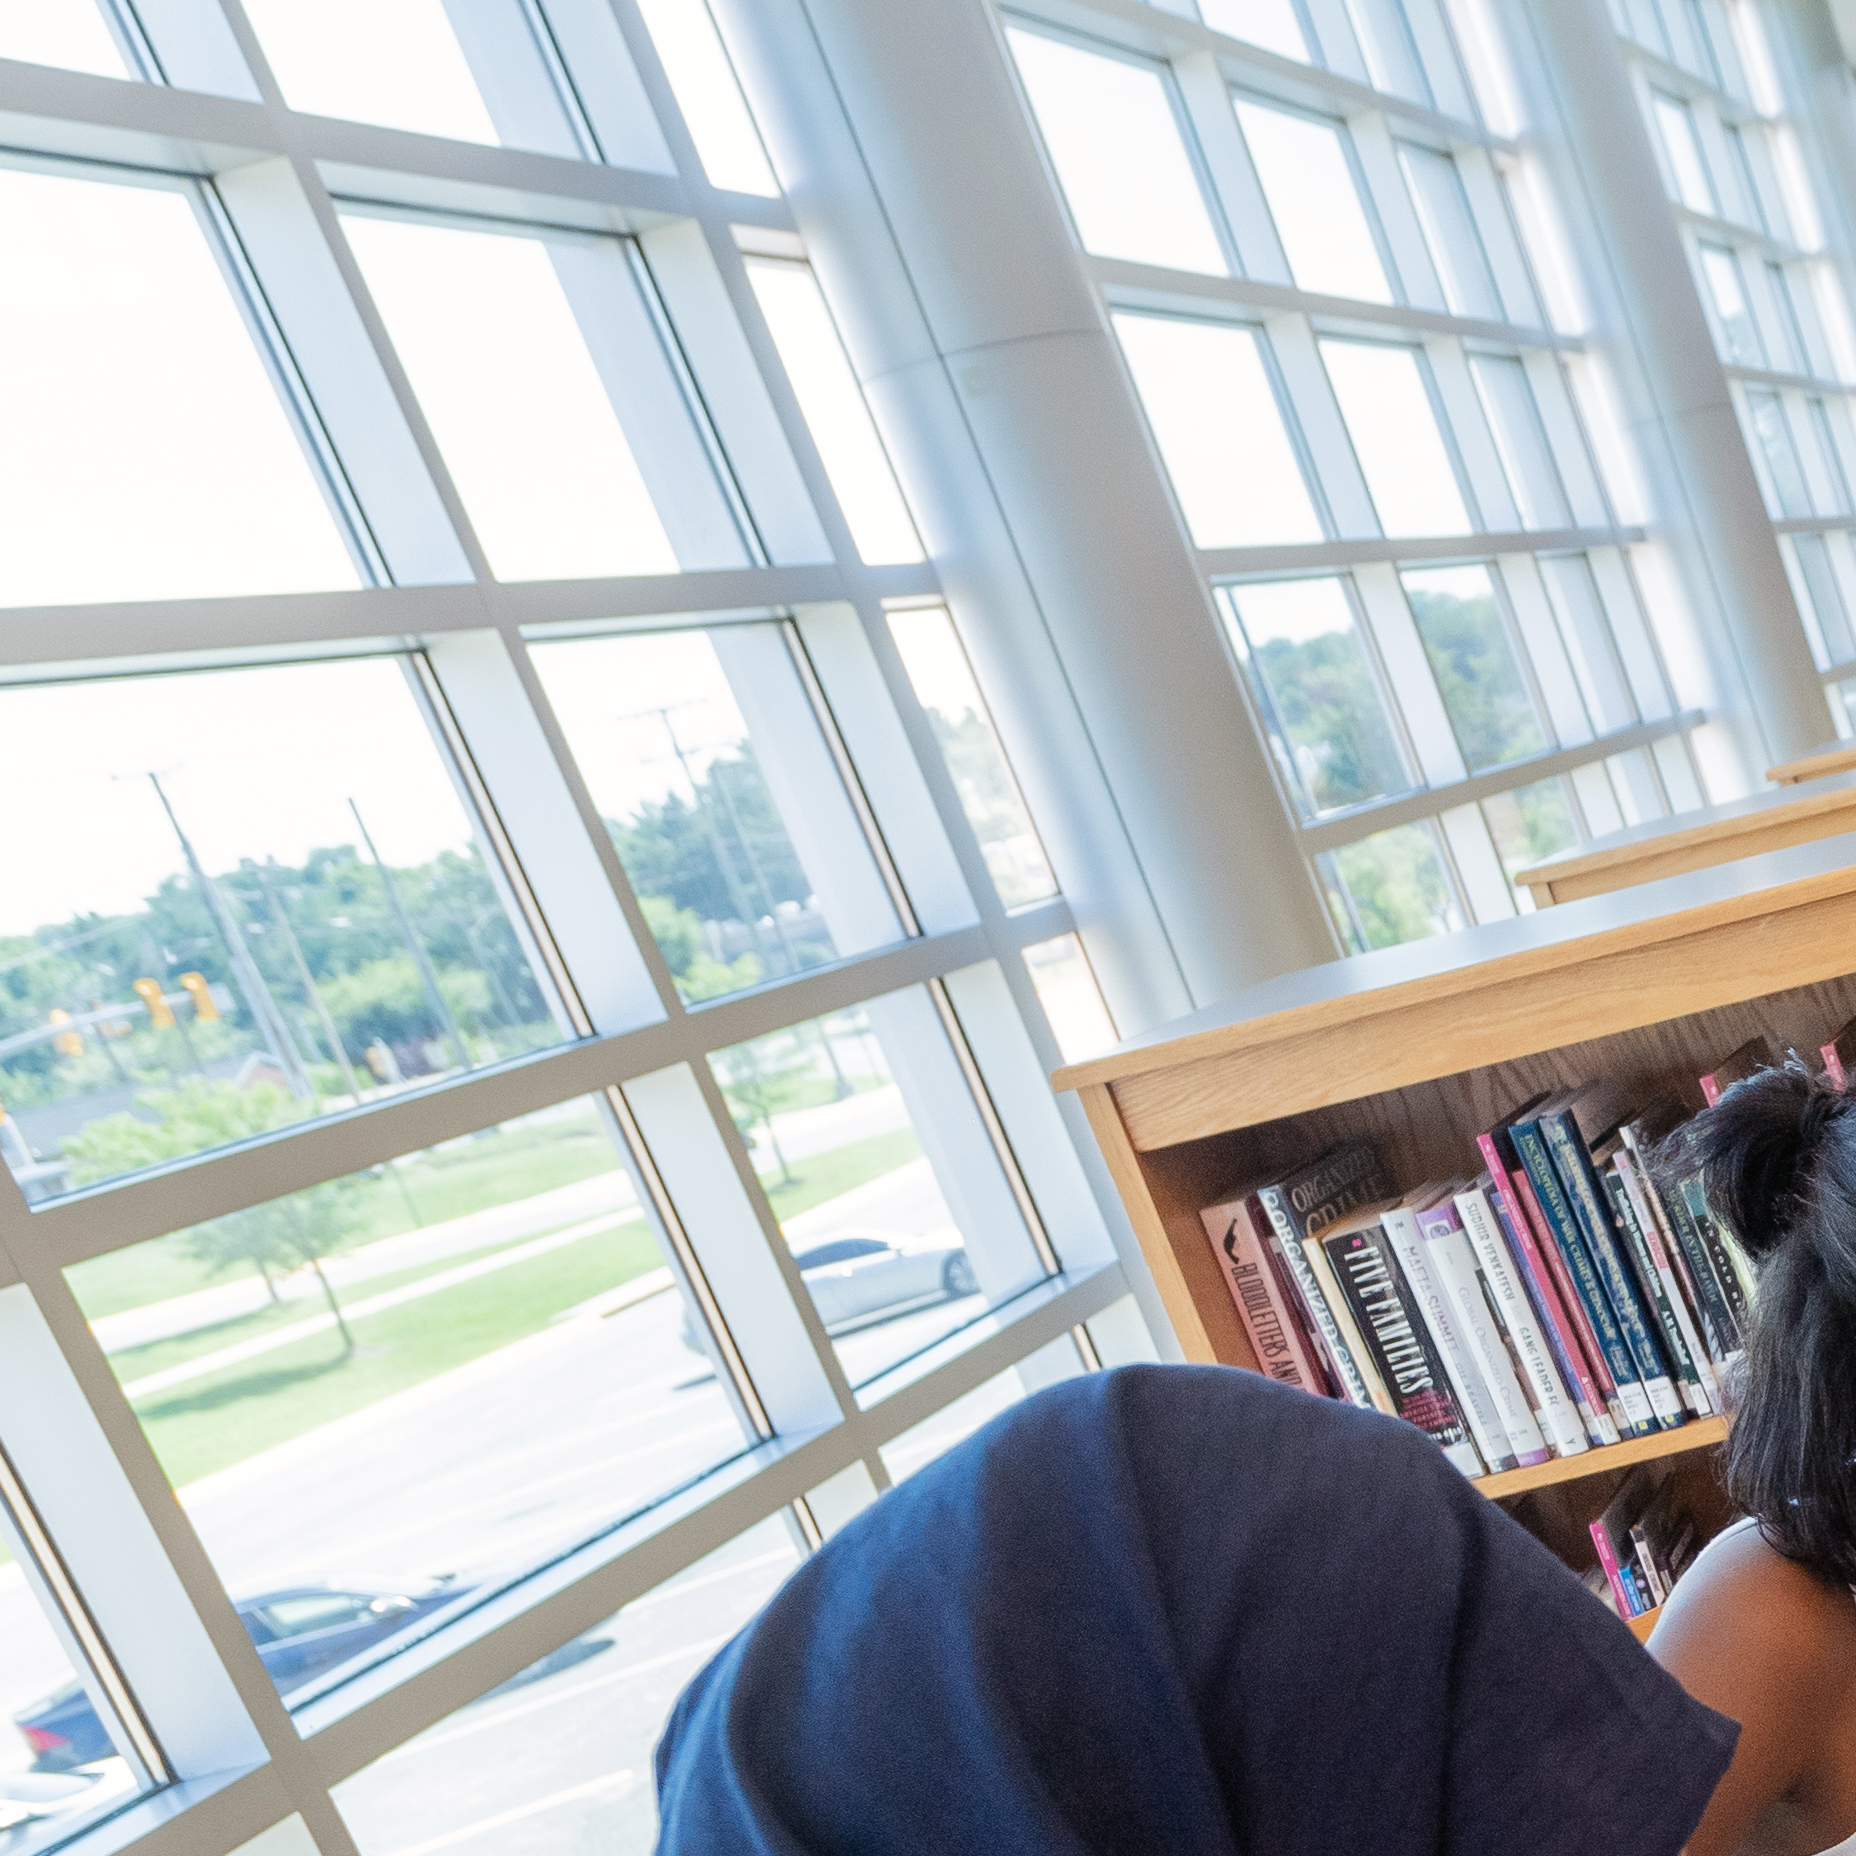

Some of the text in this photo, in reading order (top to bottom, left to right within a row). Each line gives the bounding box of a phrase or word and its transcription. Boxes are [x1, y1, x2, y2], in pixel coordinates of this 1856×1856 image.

[1265, 1203, 1340, 1341] ORGANIZED
[1521, 1132, 1616, 1340] ENCYCLOPEDIA OF WAR CRIMES GENOCIDE
[1612, 1186, 1665, 1298] Trafficking in Women and Children
[1644, 1229, 1670, 1271] GENOCIDE
[1711, 1241, 1735, 1285] COLD
[1230, 1259, 1291, 1360] BLOODLETTERS
[1342, 1242, 1435, 1398] FIVE FAMILIES
[1401, 1243, 1460, 1354] MAFIA SUMMIT
[1455, 1284, 1520, 1420] GLOBAL ORGANIZED CRIME
[1464, 1200, 1556, 1397] SUDHIR VENKATESH GANG LEADER
